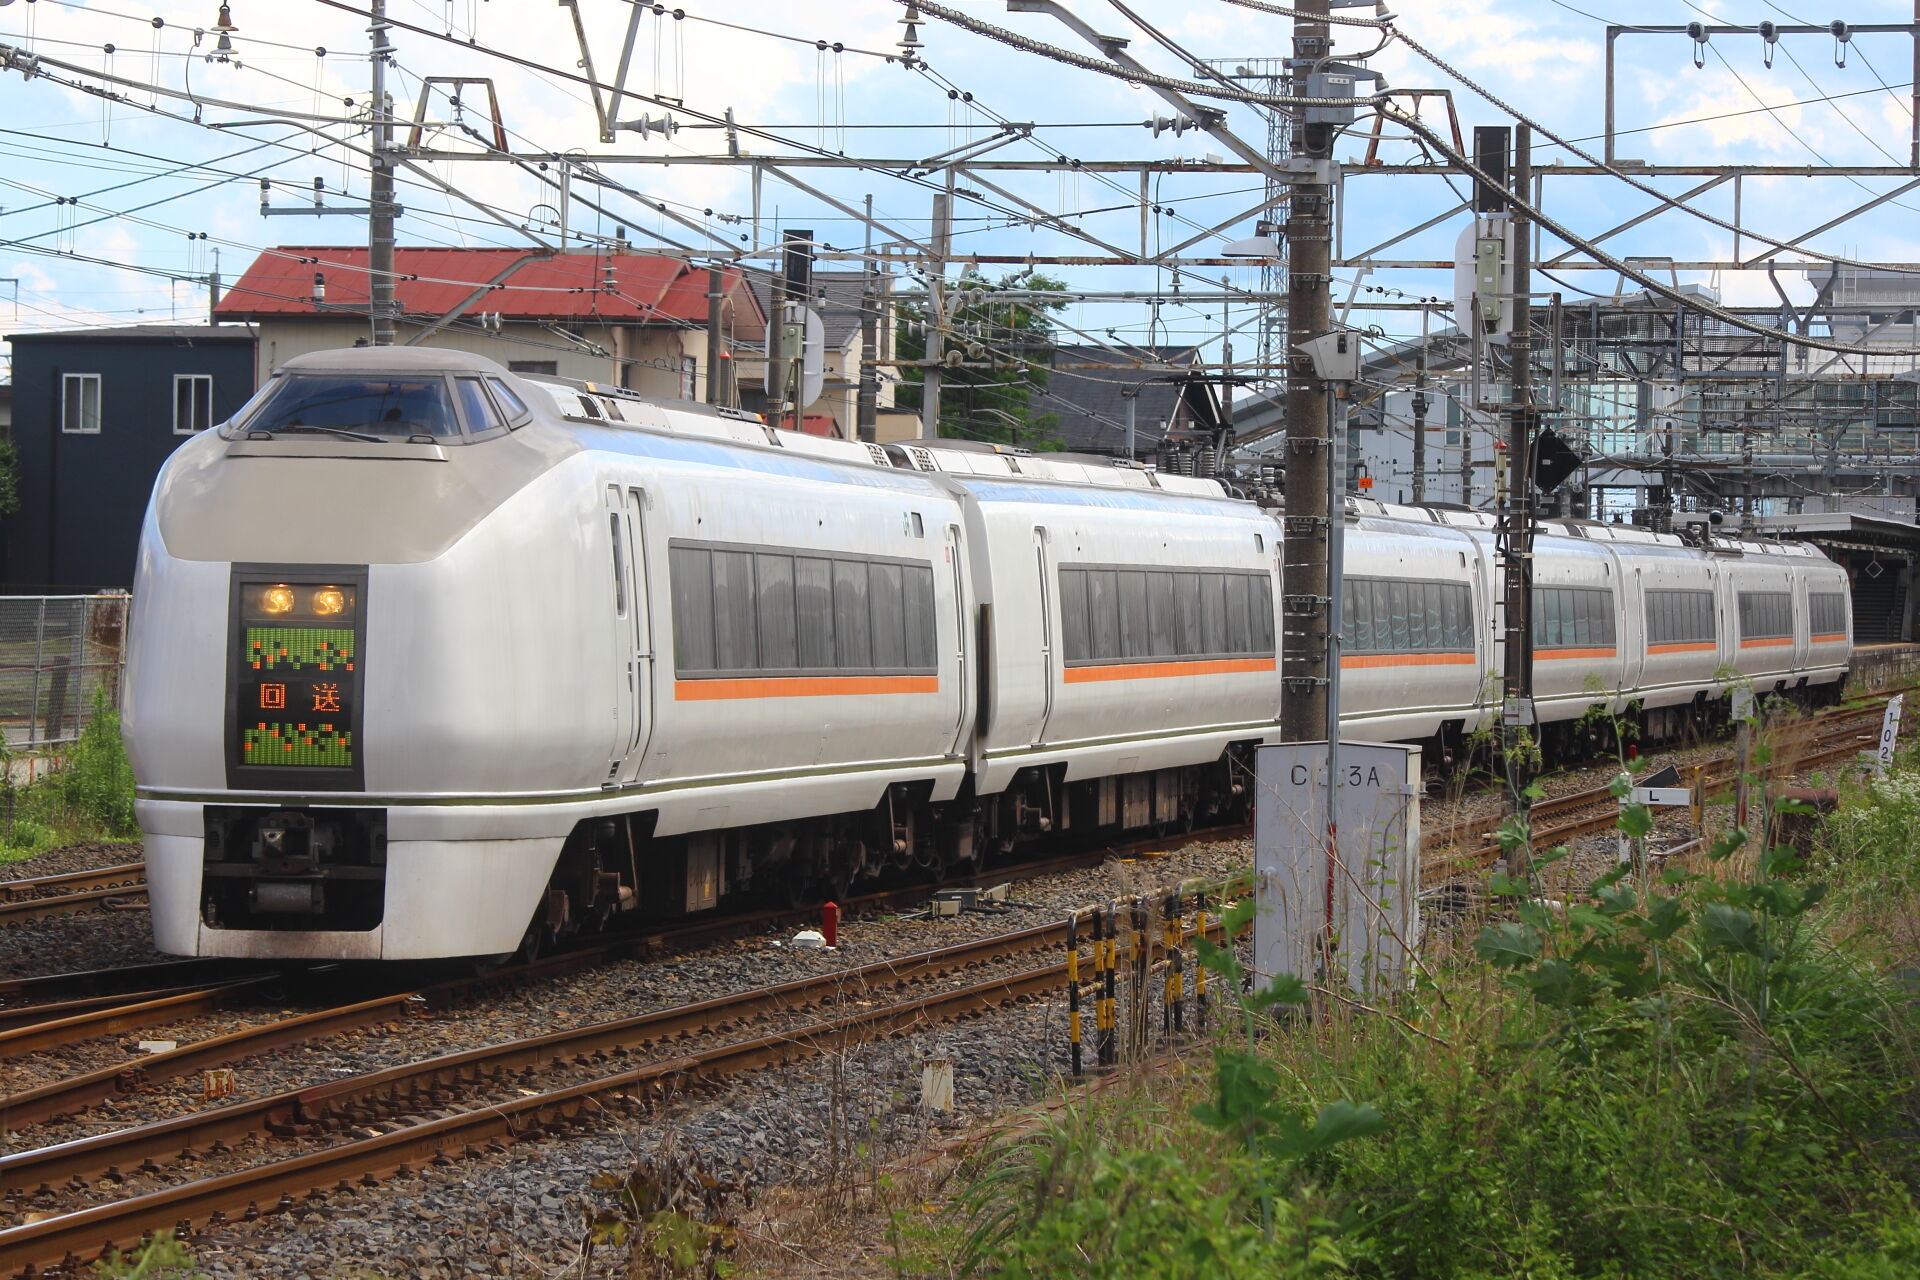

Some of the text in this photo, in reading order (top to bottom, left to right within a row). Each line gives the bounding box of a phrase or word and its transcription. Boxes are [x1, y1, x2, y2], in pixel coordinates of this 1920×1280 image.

[260, 683, 340, 712] 回送
[1881, 712, 1893, 759] 102
[1649, 790, 1660, 802] L
